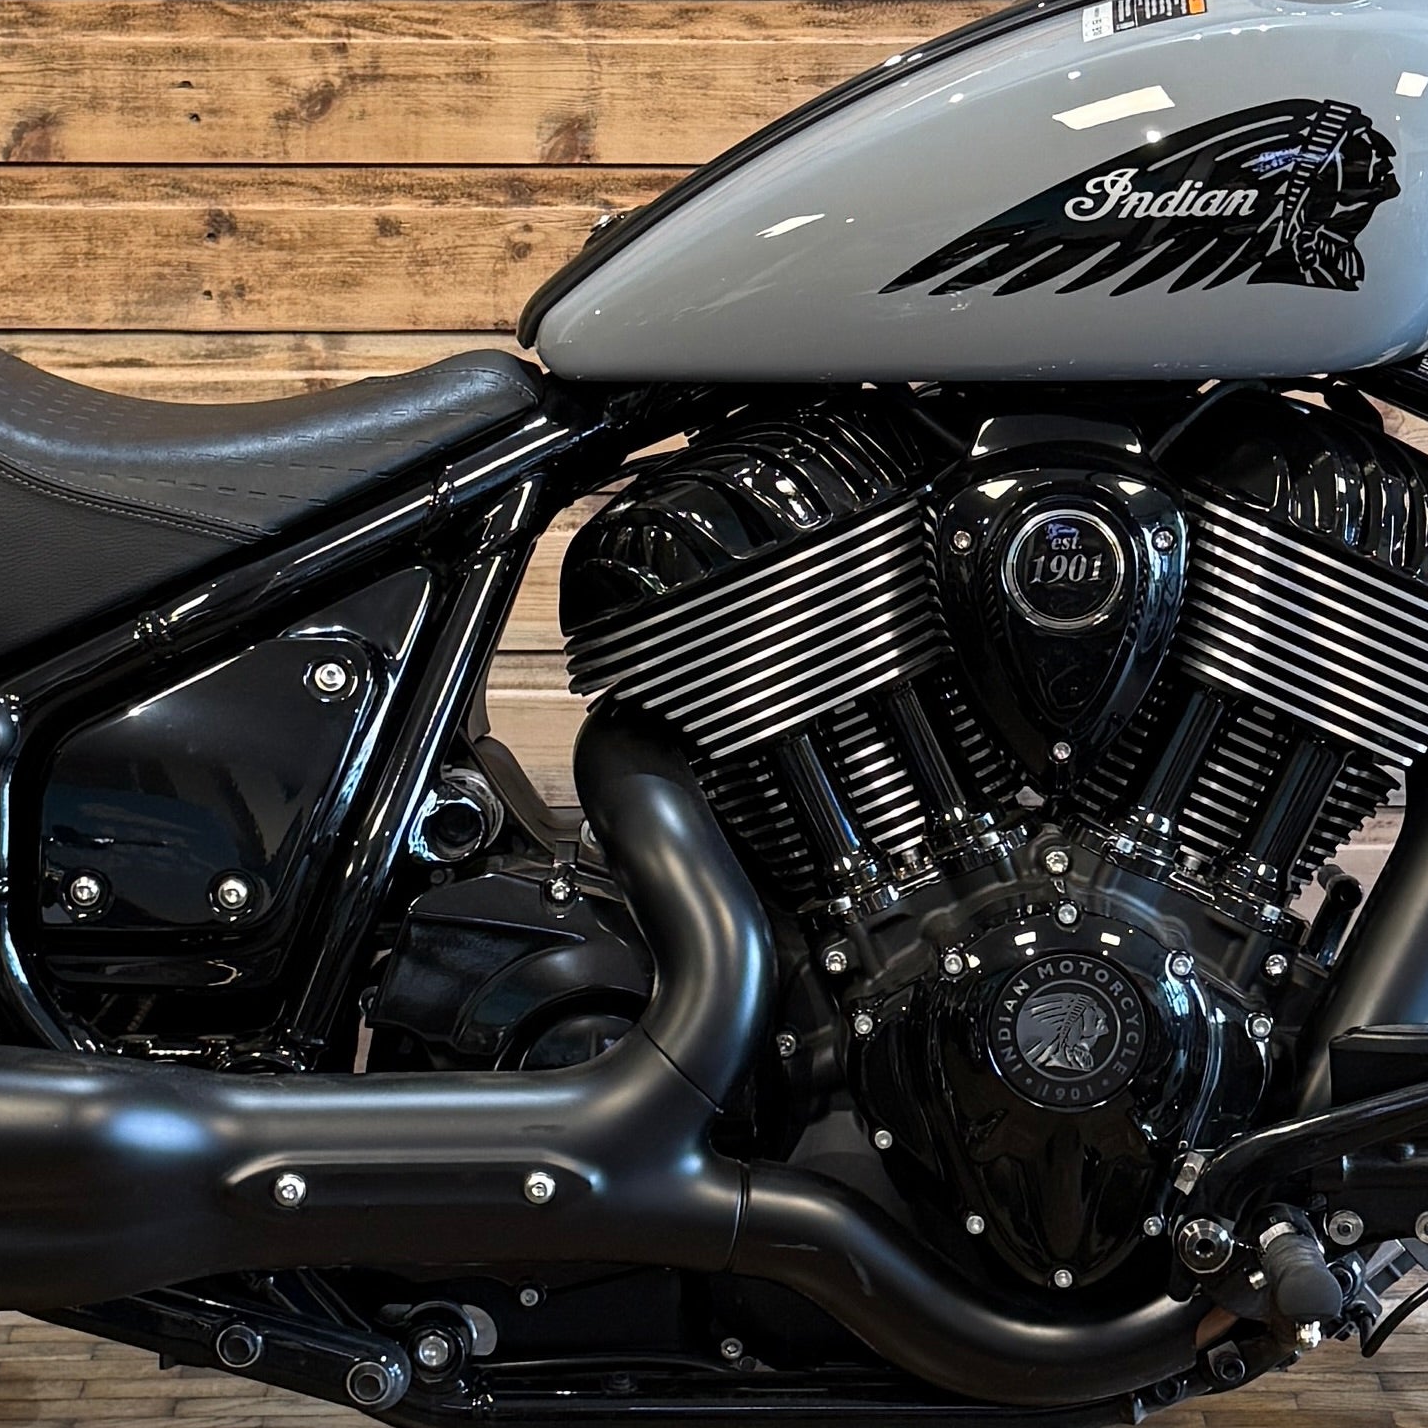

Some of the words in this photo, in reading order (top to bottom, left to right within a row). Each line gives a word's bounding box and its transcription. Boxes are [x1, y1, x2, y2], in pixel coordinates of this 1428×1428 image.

[1064, 167, 1258, 222] Indian
[1050, 535, 1083, 551] est.
[1029, 552, 1104, 586] 1901
[998, 980, 1030, 1073] INDIAN
[1037, 959, 1139, 1074] MOTORCYCLE
[1041, 1081, 1094, 1101] 1901
